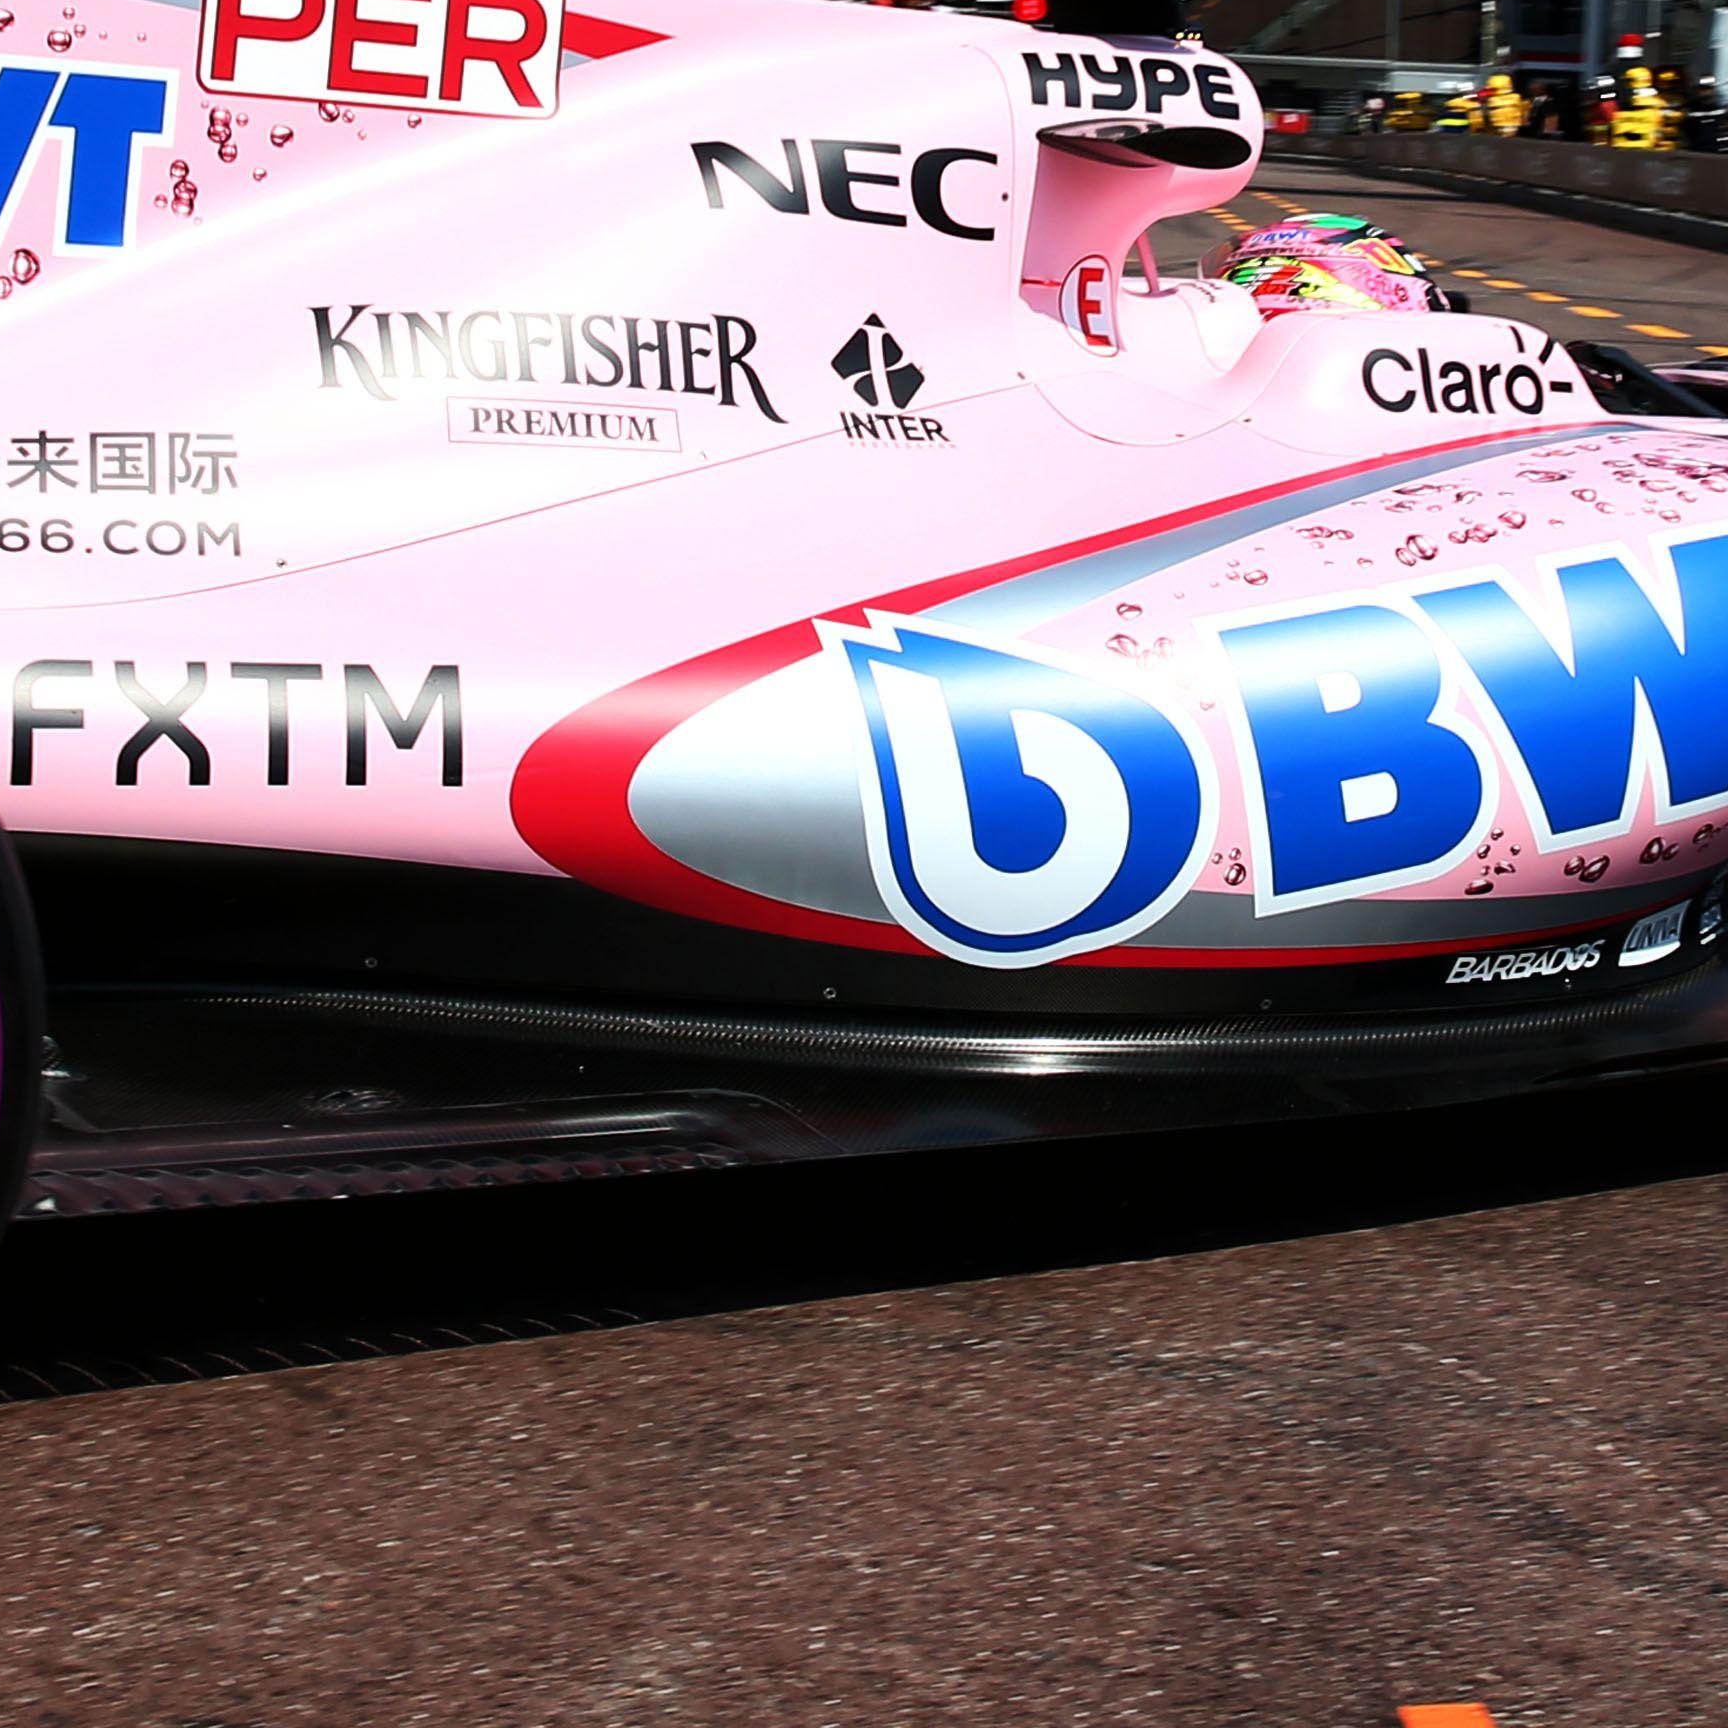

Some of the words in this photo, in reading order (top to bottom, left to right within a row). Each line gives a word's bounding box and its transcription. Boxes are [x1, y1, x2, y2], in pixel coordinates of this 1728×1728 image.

[1021, 52, 1241, 120] HYPE
[689, 138, 998, 242] NEC
[1077, 266, 1112, 347] E
[307, 303, 789, 424] KINGFISHER
[1361, 347, 1545, 415] Claro
[469, 406, 661, 443] PREMIUM
[839, 411, 951, 442] INTER
[8, 658, 465, 790] FXTM
[1445, 939, 1606, 984] BARBADOS
